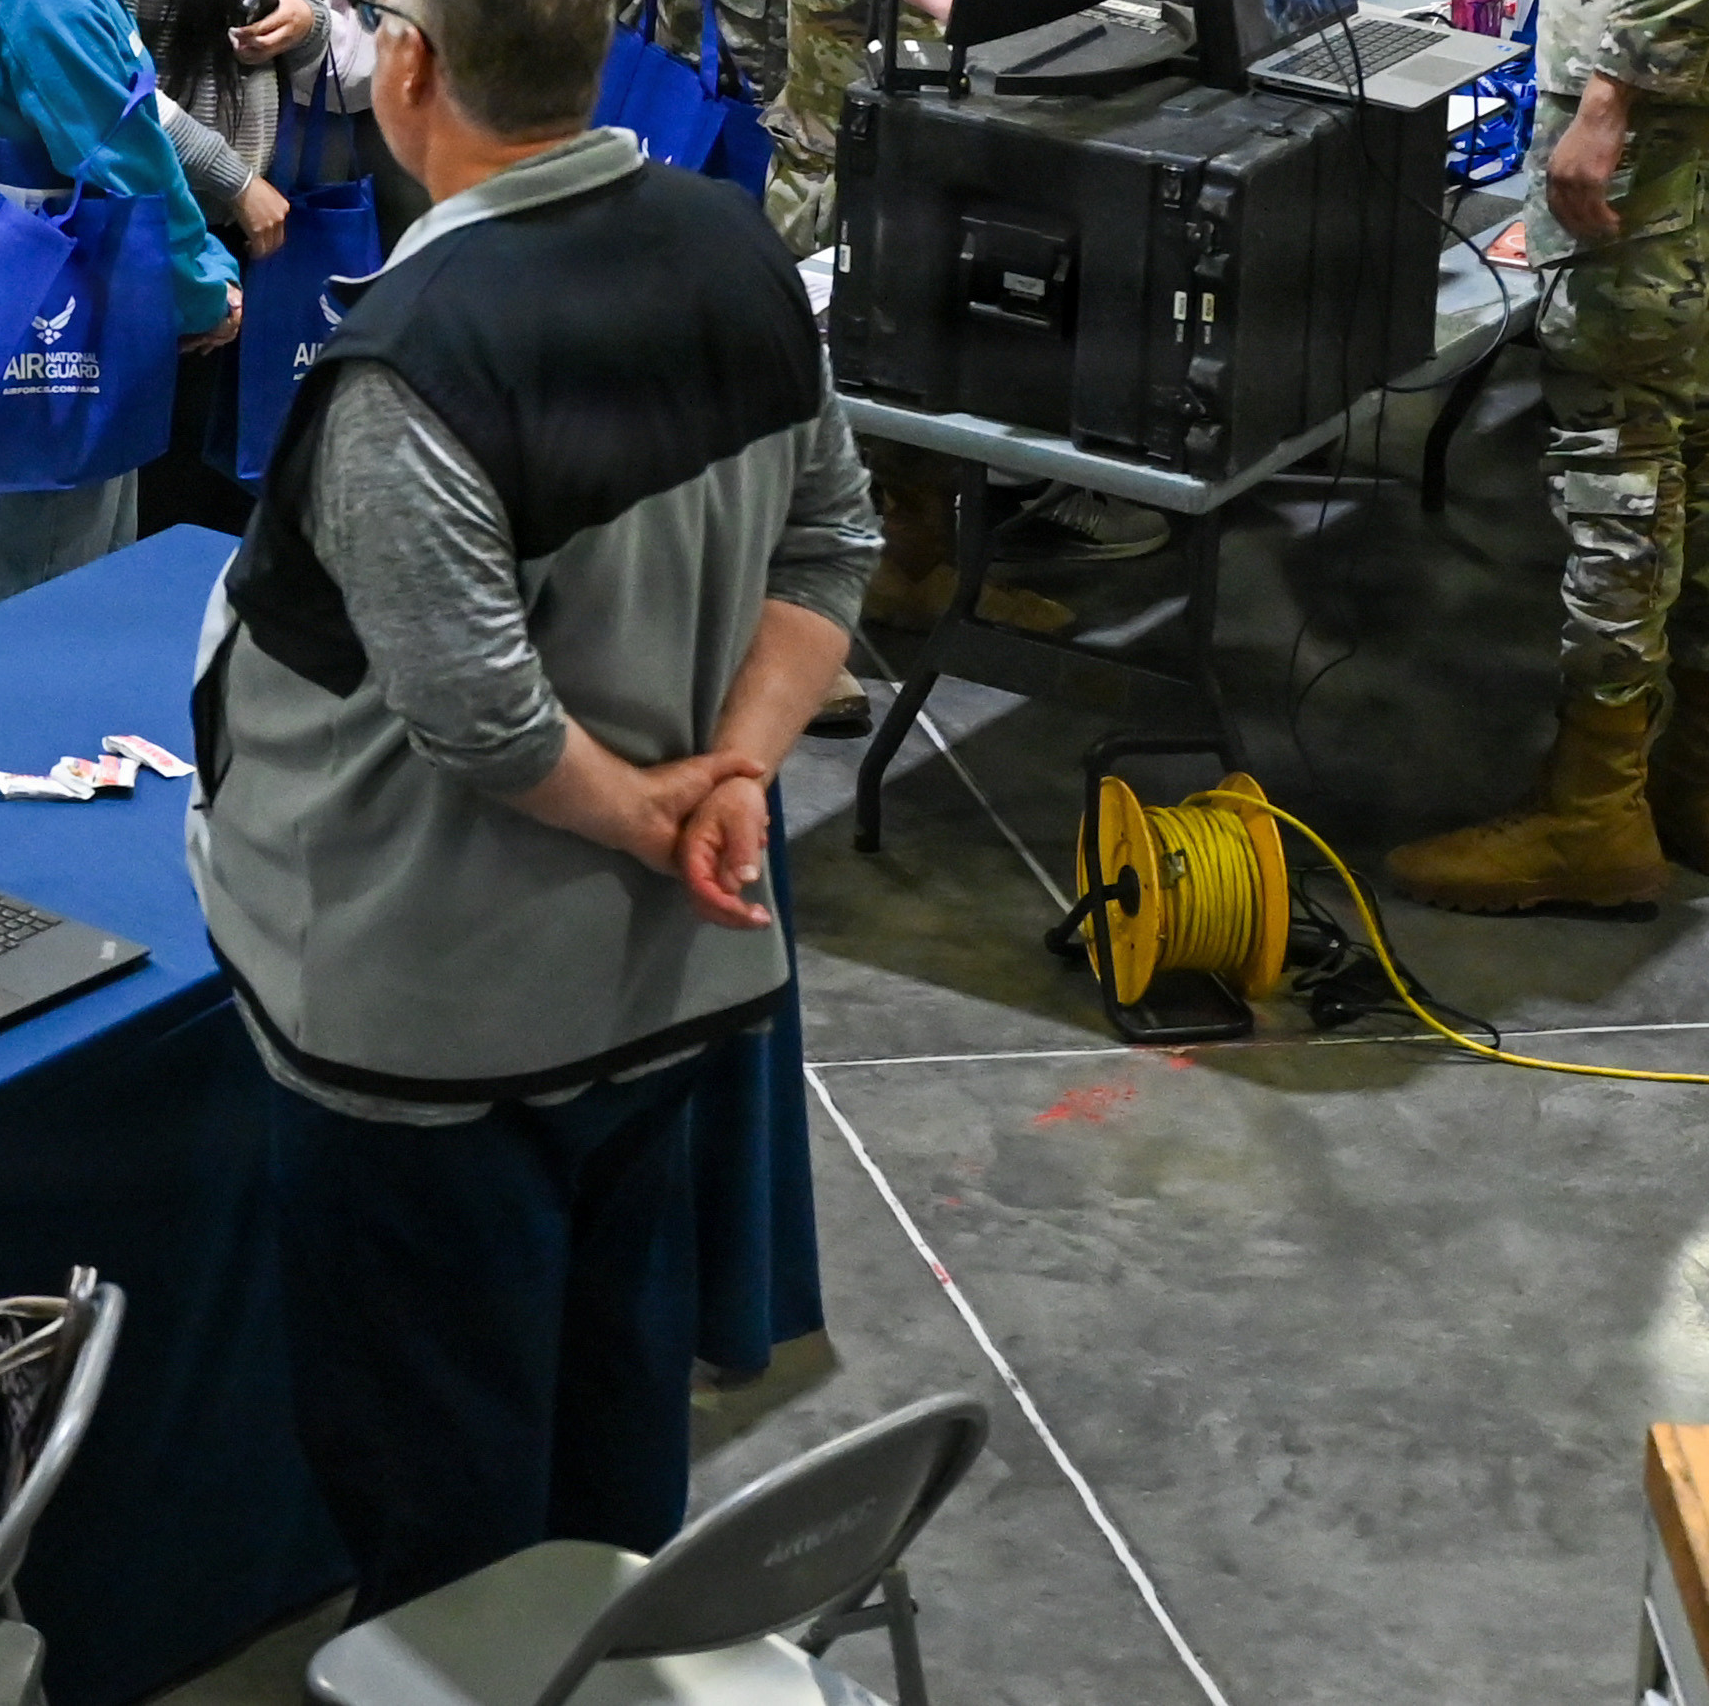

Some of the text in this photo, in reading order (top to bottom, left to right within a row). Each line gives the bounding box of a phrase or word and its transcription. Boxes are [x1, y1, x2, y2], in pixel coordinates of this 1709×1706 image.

[45, 351, 99, 365] NATIONAL
[3, 353, 44, 381] AIR
[45, 364, 100, 380] GUARD
